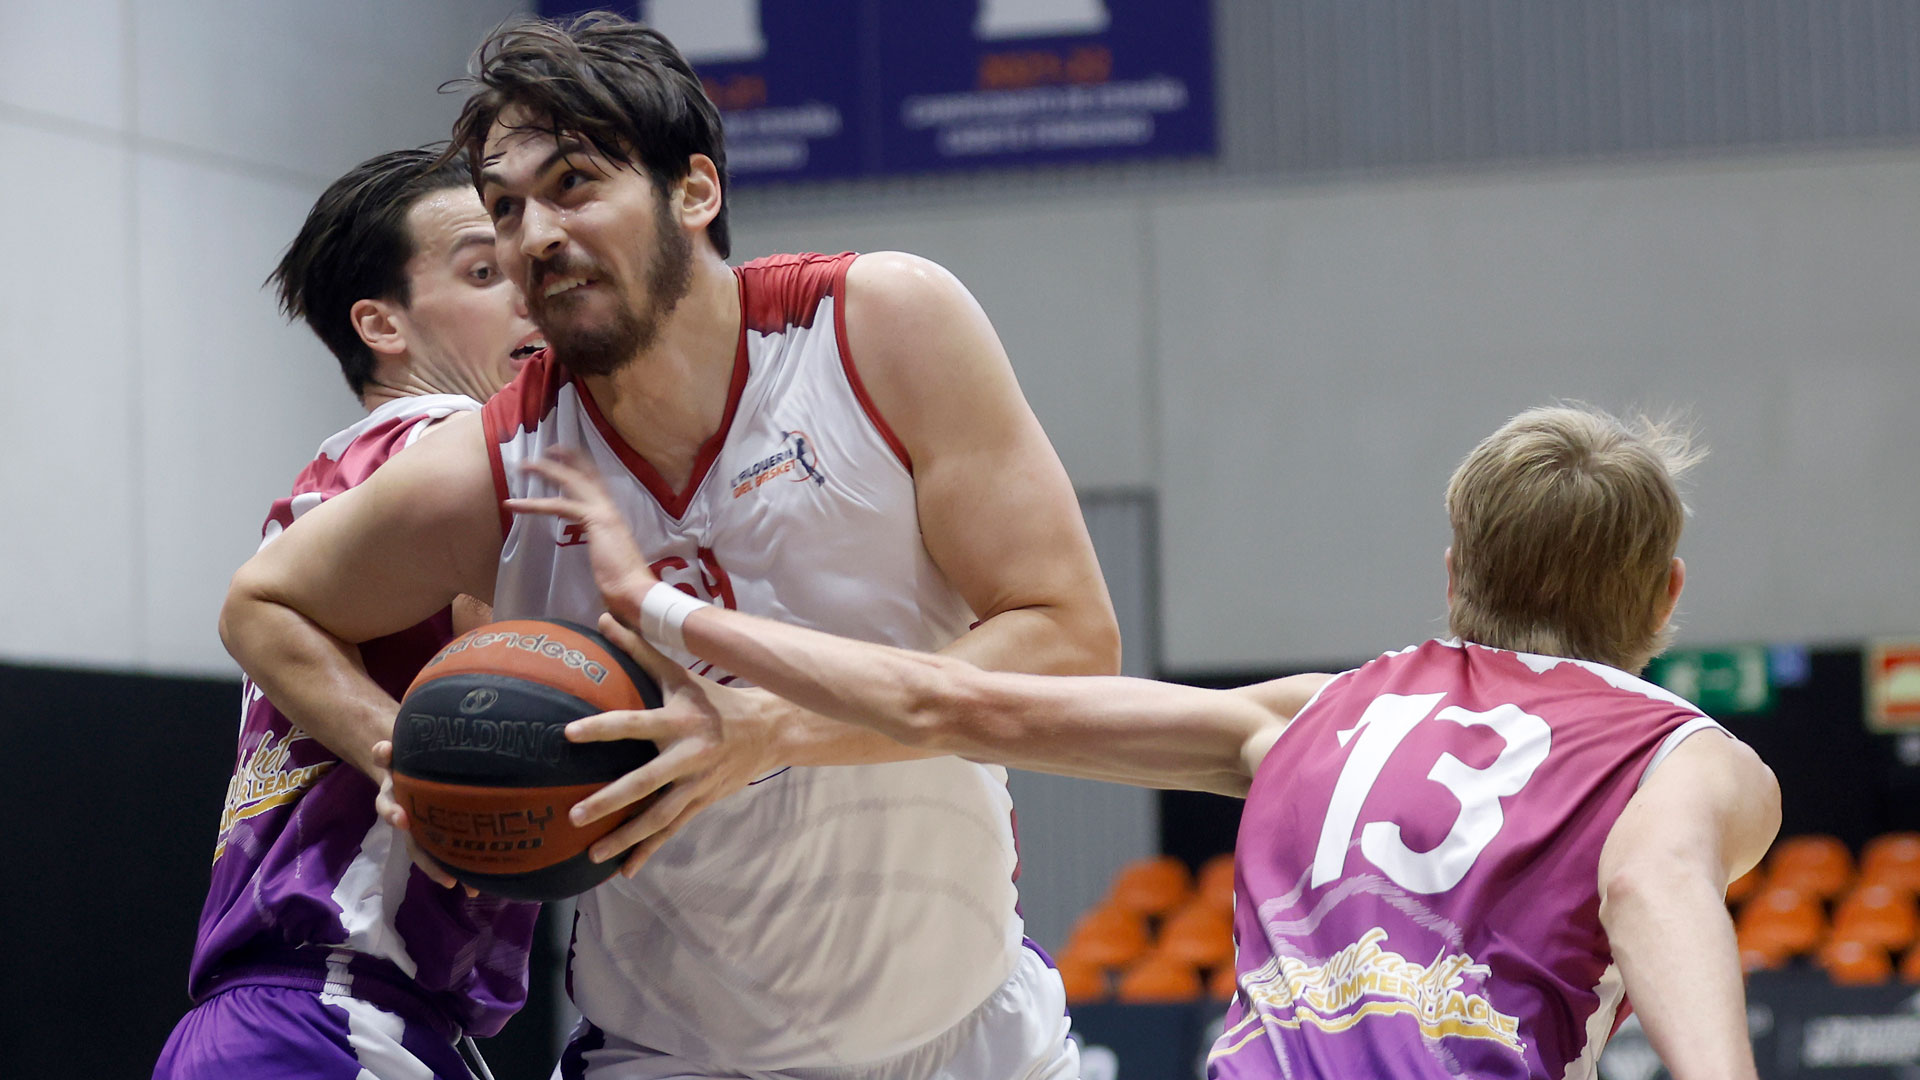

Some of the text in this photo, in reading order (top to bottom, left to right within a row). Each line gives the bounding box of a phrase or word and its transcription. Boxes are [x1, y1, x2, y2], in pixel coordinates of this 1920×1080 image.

[401, 713, 570, 763] PALDING
[1311, 692, 1552, 894] 13
[1305, 972, 1419, 1012] SUMMER
[1420, 989, 1520, 1037] LEAGUE
